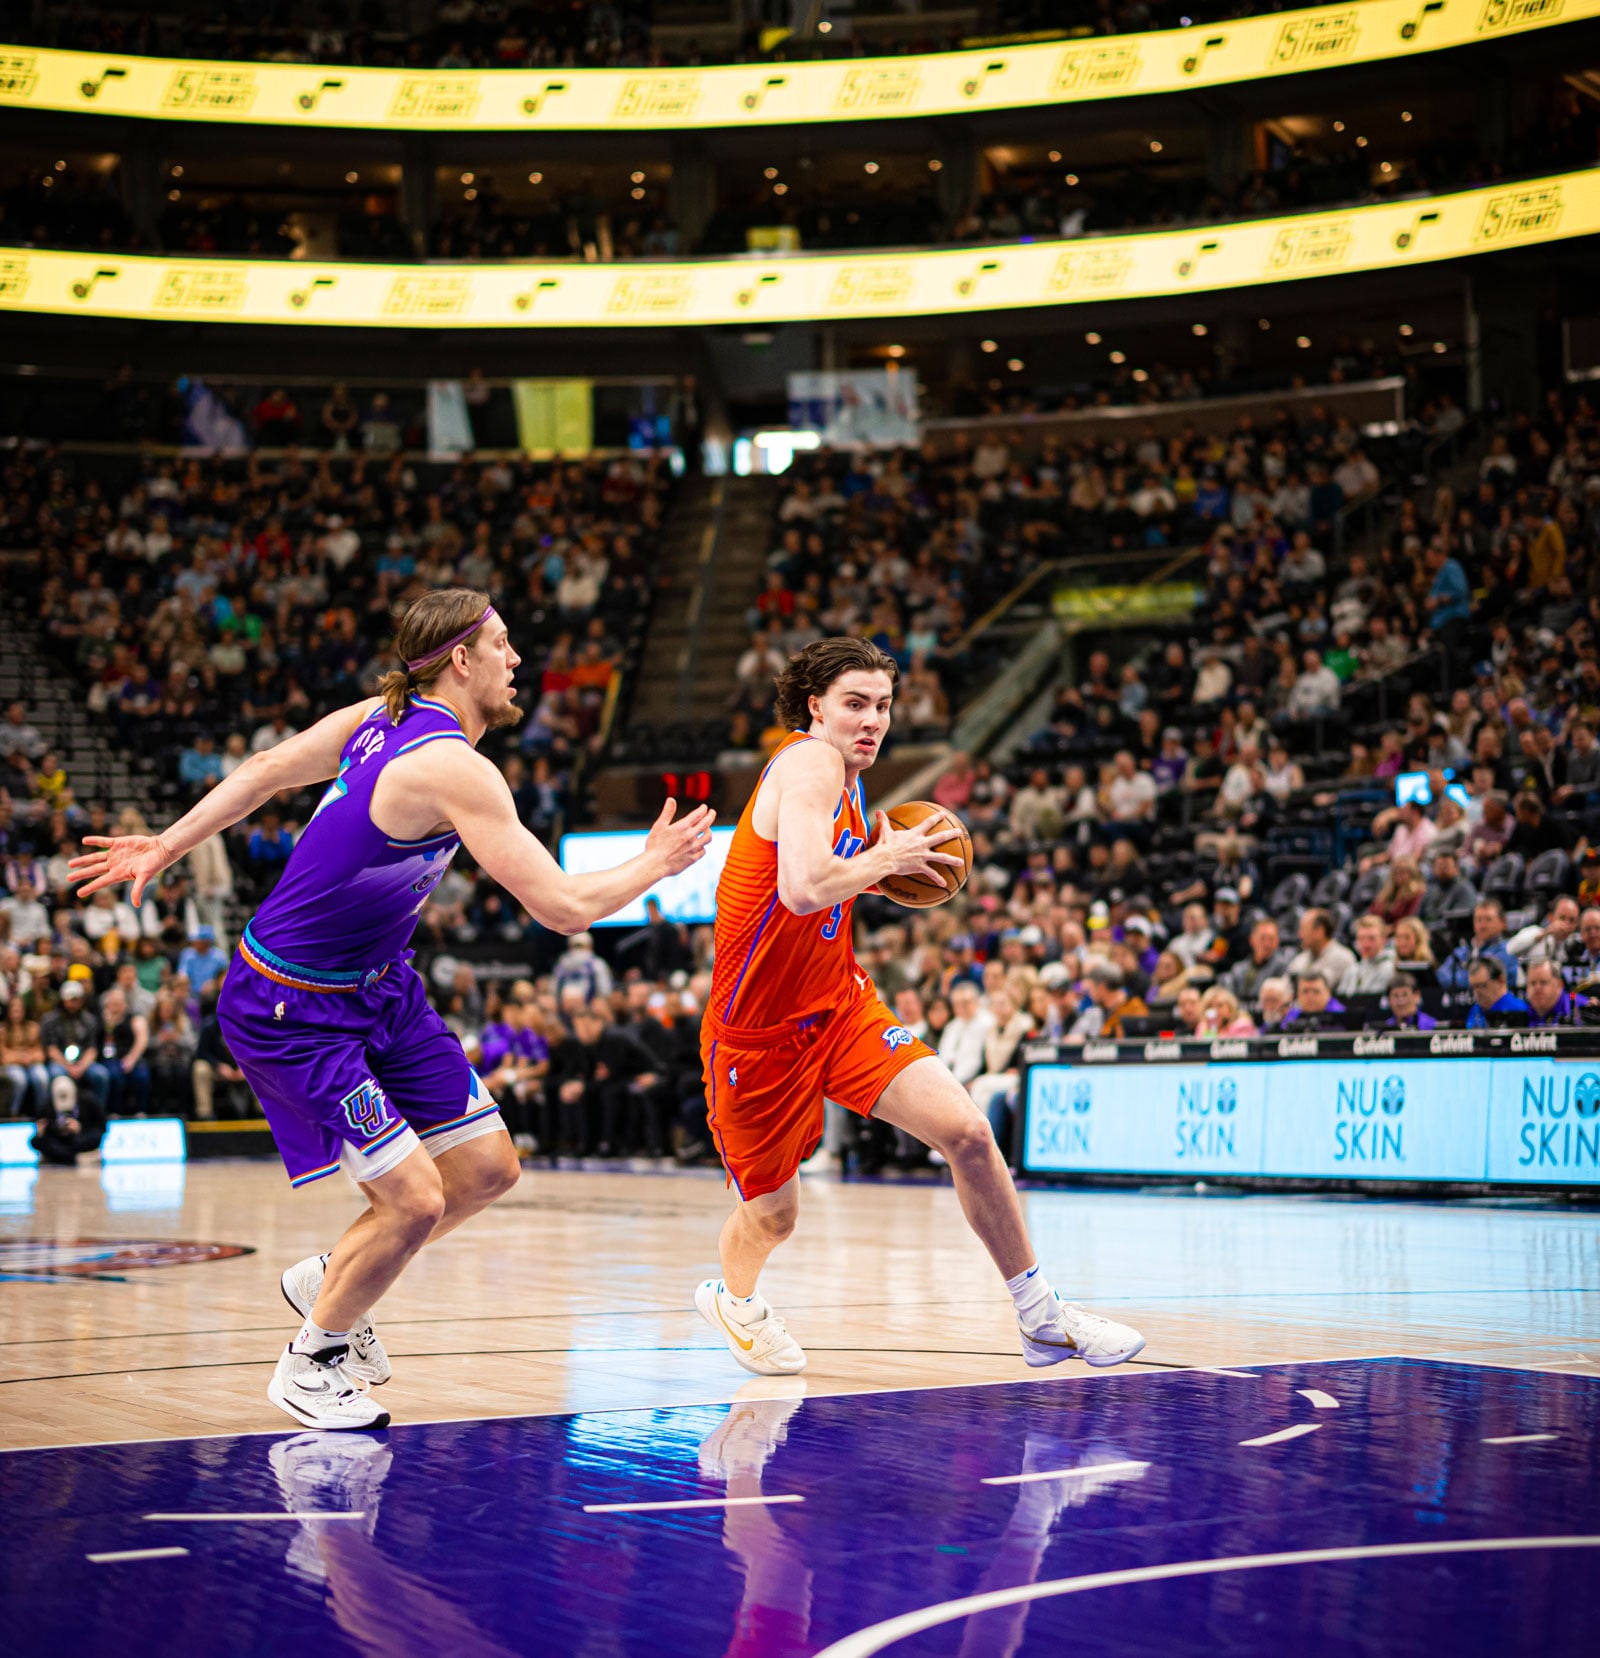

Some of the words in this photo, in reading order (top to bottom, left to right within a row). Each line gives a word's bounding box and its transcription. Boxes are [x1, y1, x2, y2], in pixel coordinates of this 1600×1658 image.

[1482, 198, 1509, 239] 5
[1177, 1080, 1214, 1116] NU
[1336, 1079, 1378, 1117] NU
[1522, 1076, 1571, 1119] NU
[1036, 1120, 1090, 1155] SKIN
[1175, 1121, 1235, 1157] SKIN
[1334, 1121, 1403, 1161] SKIN
[1519, 1121, 1600, 1167] SKIN
